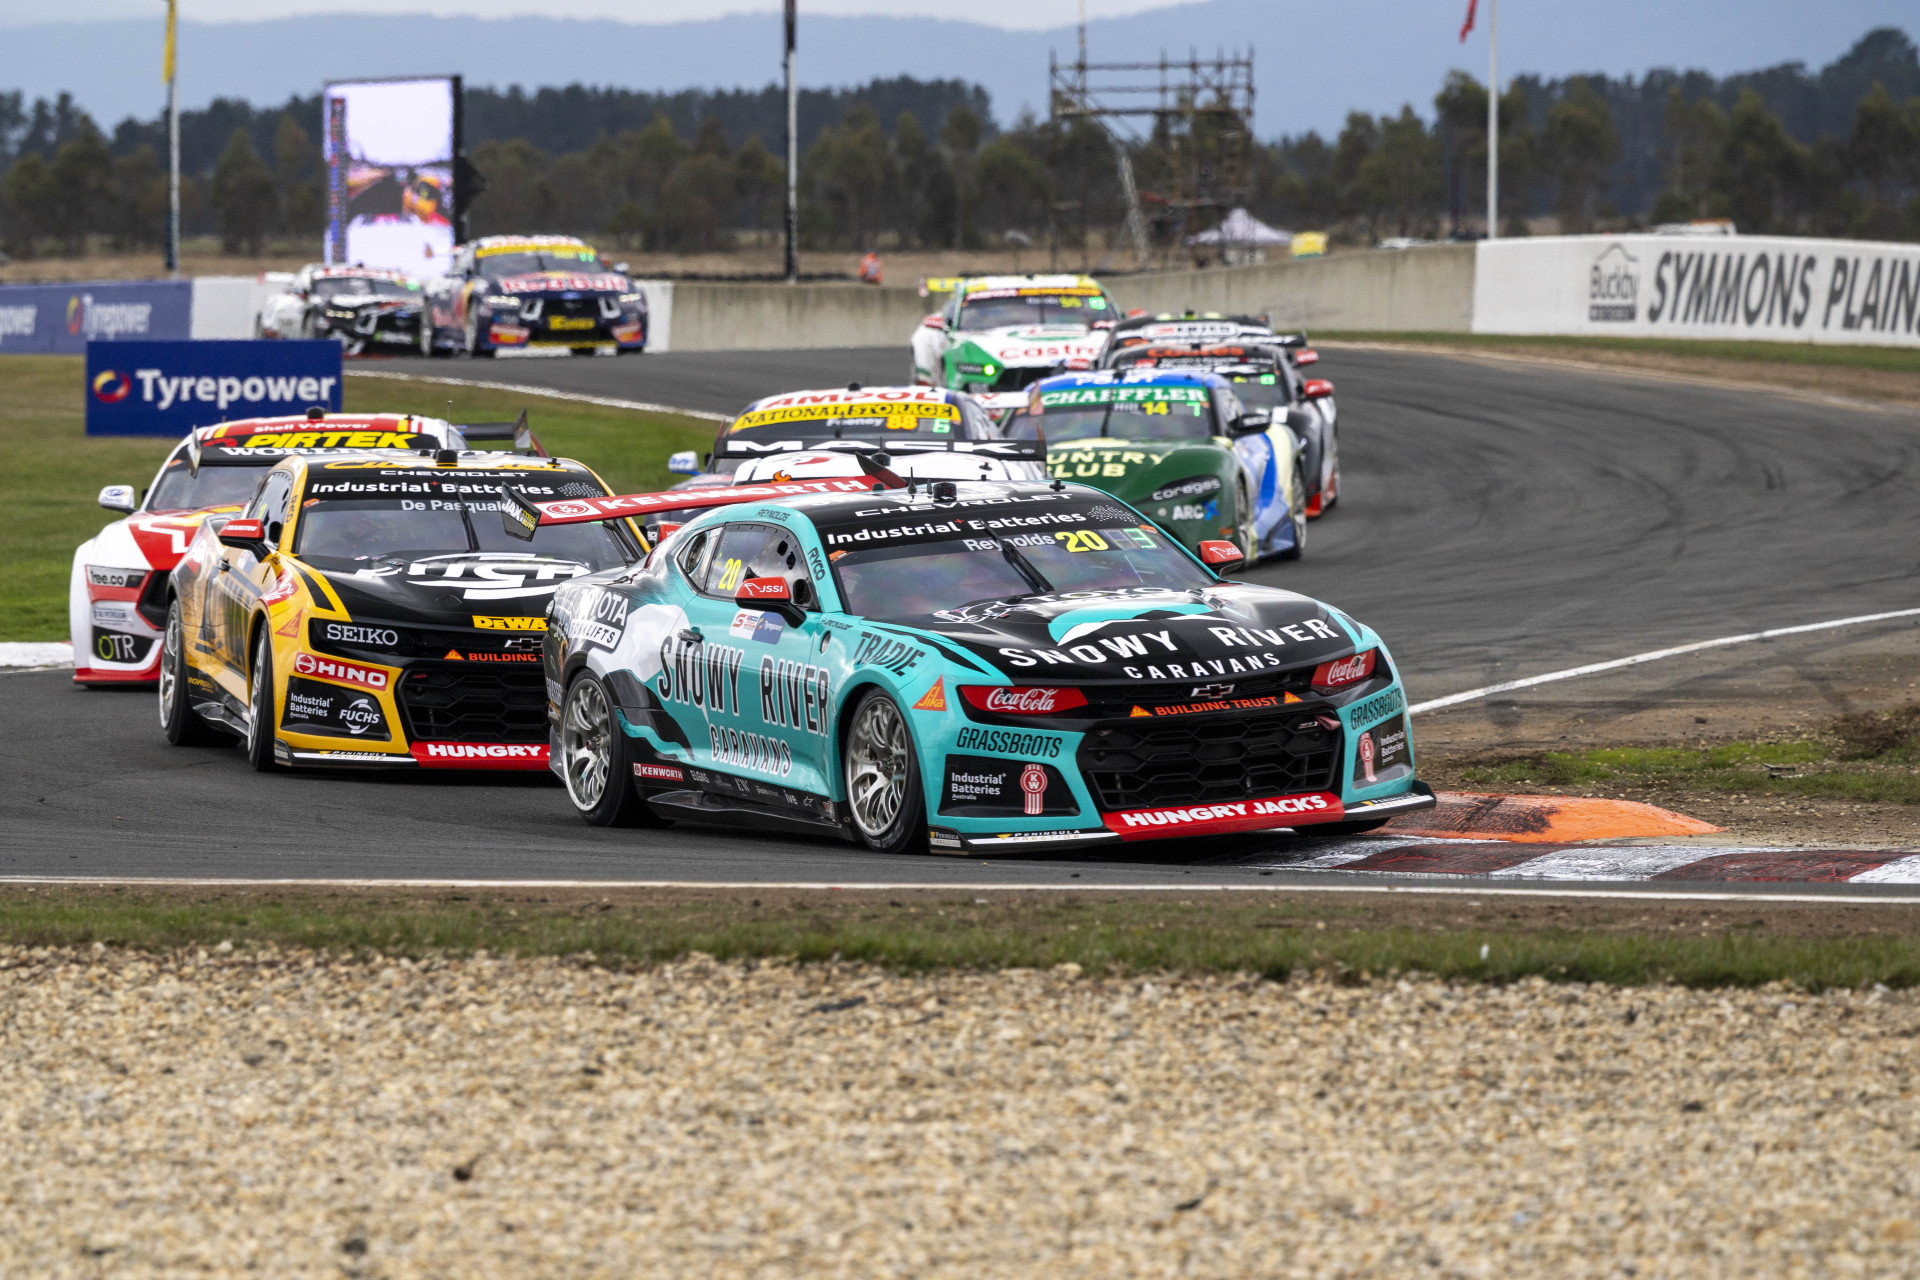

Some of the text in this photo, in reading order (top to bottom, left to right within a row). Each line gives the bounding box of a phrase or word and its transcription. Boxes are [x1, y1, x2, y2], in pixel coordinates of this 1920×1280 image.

[1647, 250, 1920, 338] SYMMONS PLAIN
[136, 369, 336, 410] Tyrepower
[1040, 387, 1208, 406] CHAEFFLER
[764, 391, 939, 409] AMPOL
[1141, 401, 1168, 415] 14
[742, 402, 953, 426] NATIONAL STORAGE
[885, 415, 919, 429] 88
[254, 424, 293, 433] Shell
[243, 430, 418, 449] PIRTEK
[727, 440, 1022, 454] MACK
[380, 470, 529, 478] CHEVROLET
[1046, 463, 1126, 478] LUB
[311, 482, 431, 494] Industrial
[597, 480, 869, 511] KENWORTH
[1152, 478, 1221, 500] coregas
[401, 500, 502, 514] De Pasqual
[855, 493, 1073, 517] CHEVROLET
[755, 508, 790, 522] REYNOLDS
[827, 512, 1087, 545] Industrial Batteries
[1054, 529, 1109, 553] 20
[808, 546, 826, 581] RYCO
[717, 558, 742, 591] 20
[759, 585, 783, 593] JSSI
[326, 623, 399, 646] SEIKO
[998, 618, 1340, 667] SNOWY RIVER
[98, 635, 137, 660] OTR
[468, 652, 537, 662] BUILDING
[852, 631, 926, 677] TRADIE
[317, 661, 387, 687] HINO
[1122, 652, 1281, 679] CARAVANS
[657, 636, 831, 738] SNOWY RIVER
[290, 692, 330, 708] Industrial
[986, 687, 1059, 711] Coca-Cola
[1154, 700, 1229, 716] BUILDING
[1230, 696, 1279, 710] TRUST
[290, 702, 328, 717] Batteries
[339, 709, 380, 724] FUCHS
[426, 744, 542, 758] HUNGRY
[709, 722, 793, 778] CARAVANS
[641, 766, 683, 780] KENWORTH
[951, 772, 1003, 785] Industrial
[951, 783, 1001, 796] Batteries
[1121, 795, 1328, 827] HUNGRY JACK'S
